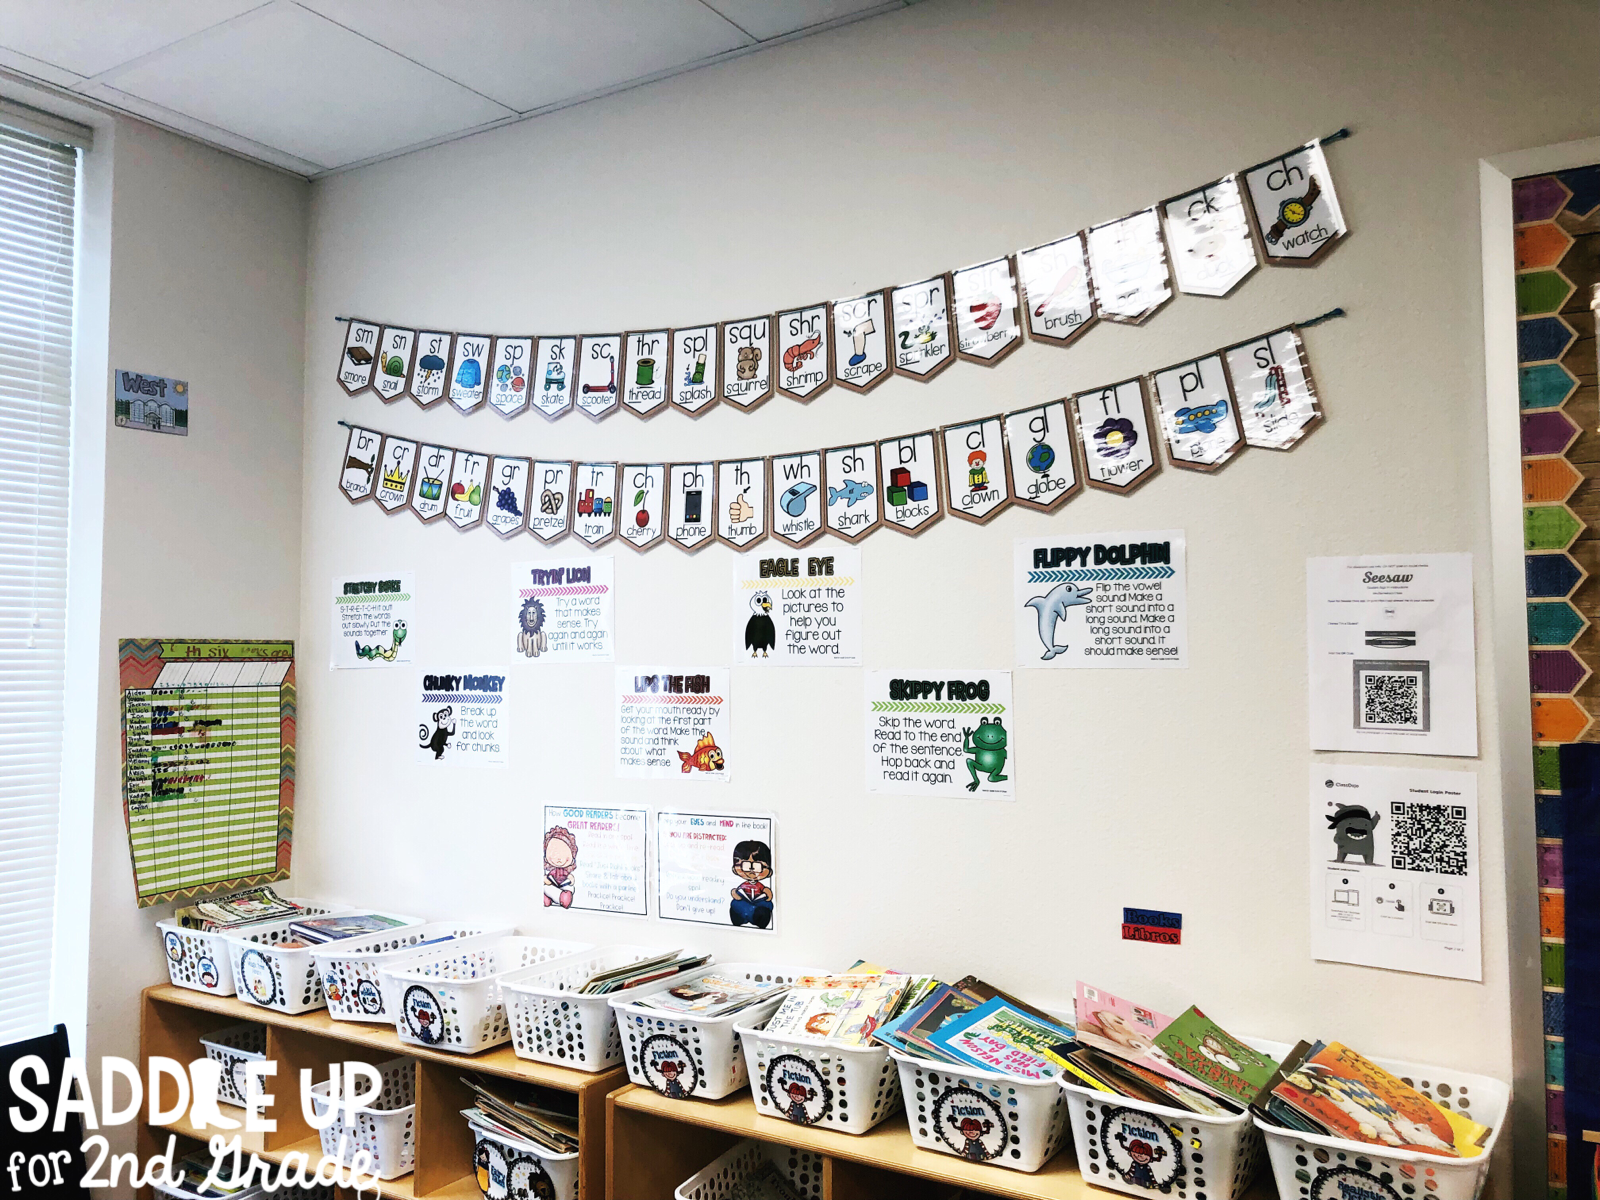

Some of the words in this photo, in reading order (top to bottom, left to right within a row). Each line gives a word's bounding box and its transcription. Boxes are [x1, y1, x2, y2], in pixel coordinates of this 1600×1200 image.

[1266, 159, 1303, 191] ch
[1283, 224, 1328, 251] watch
[789, 315, 820, 335] shr
[1044, 311, 1082, 329] brush
[355, 328, 373, 344] sm
[392, 334, 407, 350] sn
[729, 321, 766, 347] squ
[429, 337, 442, 354] st
[463, 341, 484, 357] sw
[550, 339, 565, 360] sk
[591, 343, 611, 359] sc
[637, 334, 660, 356] thr
[683, 329, 708, 358] spl
[505, 344, 523, 365] sp
[1254, 336, 1276, 369] sl
[844, 361, 883, 378] scrape
[122, 372, 167, 397] West
[344, 372, 367, 384] smore
[382, 380, 399, 391] snail
[786, 371, 823, 387] shrimp
[1179, 361, 1204, 401] pl
[417, 385, 439, 396] storm
[451, 389, 482, 399] sweater
[628, 388, 661, 401] thread
[726, 377, 768, 396] squirrel
[496, 394, 523, 404] space
[541, 394, 564, 404] skate
[582, 395, 613, 405] scooter
[679, 389, 712, 402] splash
[1099, 387, 1120, 415] fl
[1029, 407, 1049, 443] gl
[357, 430, 373, 451] br
[966, 422, 985, 450] cl
[393, 446, 409, 461] cr
[428, 449, 445, 467] dr
[898, 437, 917, 464] bl
[464, 455, 479, 476] fr
[842, 448, 864, 473] sh
[501, 465, 520, 486] gr
[544, 469, 563, 488] pr
[591, 469, 603, 486] tr
[633, 466, 654, 488] ch
[683, 465, 704, 493] ph
[735, 465, 750, 485] th
[346, 480, 368, 493] branch
[1027, 475, 1066, 497] globe
[380, 490, 405, 503] crown
[962, 488, 999, 506] clown
[419, 503, 437, 512] drum
[454, 505, 473, 518] fruit
[895, 504, 929, 520] blocks
[492, 515, 520, 526] grapes
[533, 516, 565, 529] pretzel
[838, 510, 870, 526] shark
[584, 524, 604, 535] train
[627, 525, 656, 538] cherry
[676, 525, 706, 538] phone
[728, 523, 757, 536] thumb
[782, 520, 815, 533] whistle
[1033, 547, 1091, 569] FLIPPY
[1094, 541, 1170, 566] DOLPHIN
[566, 566, 591, 584] LION
[759, 558, 799, 578] EAGLE
[808, 556, 834, 576] EYE
[1363, 571, 1413, 584] Seesaw
[782, 589, 806, 599] Look
[809, 588, 822, 599] at
[826, 587, 845, 598] the
[1096, 583, 1111, 592] Flip
[1113, 583, 1130, 591] the
[1133, 582, 1161, 590] vowel
[783, 602, 828, 615] pictures
[831, 602, 844, 612] to
[1086, 605, 1113, 613] short
[1116, 604, 1145, 612] sound
[789, 616, 811, 629] help
[815, 617, 836, 629] you
[1086, 615, 1105, 625] long
[1140, 614, 1165, 622] Make
[785, 630, 819, 643] figure
[822, 630, 842, 640] out
[208, 646, 229, 657] six
[787, 643, 806, 654] the
[809, 643, 840, 654] word.
[1085, 647, 1115, 655] should
[1117, 647, 1143, 655] make
[423, 674, 462, 692] CHUNKY
[463, 675, 505, 692] MONKEY
[661, 675, 683, 693] THE
[685, 674, 710, 694] FISH
[889, 679, 945, 701] SKIPPY
[947, 679, 990, 701] FROG
[879, 716, 900, 729] Skip
[902, 717, 921, 728] the
[924, 718, 956, 729] word.
[875, 729, 901, 741] Read
[904, 730, 916, 741] to
[918, 731, 938, 742] the
[940, 732, 962, 742] end
[873, 743, 888, 753] of
[890, 743, 909, 753] the
[911, 745, 964, 756] sentence.
[881, 757, 902, 769] Hop
[904, 758, 931, 768] back
[934, 758, 955, 770] and
[568, 821, 587, 829] GREAT
[690, 818, 704, 826] EYES
[1126, 910, 1180, 928] Books
[1123, 926, 1179, 944] Libros
[412, 998, 432, 1010] Fiction
[766, 1017, 781, 1032] JUST
[779, 1004, 791, 1015] ME
[780, 1016, 794, 1028] THE
[790, 1001, 804, 1013] TUB
[978, 1037, 1006, 1049] DAY
[652, 1050, 679, 1061] Fiction
[959, 1039, 1004, 1065] NELSON
[1011, 1050, 1046, 1068] FIELD
[1003, 1055, 1030, 1068] HAS
[782, 1070, 811, 1084] Fiction
[1004, 1064, 1040, 1079] MISS
[950, 1105, 985, 1117] Fiction
[1122, 1123, 1159, 1142] Fiction
